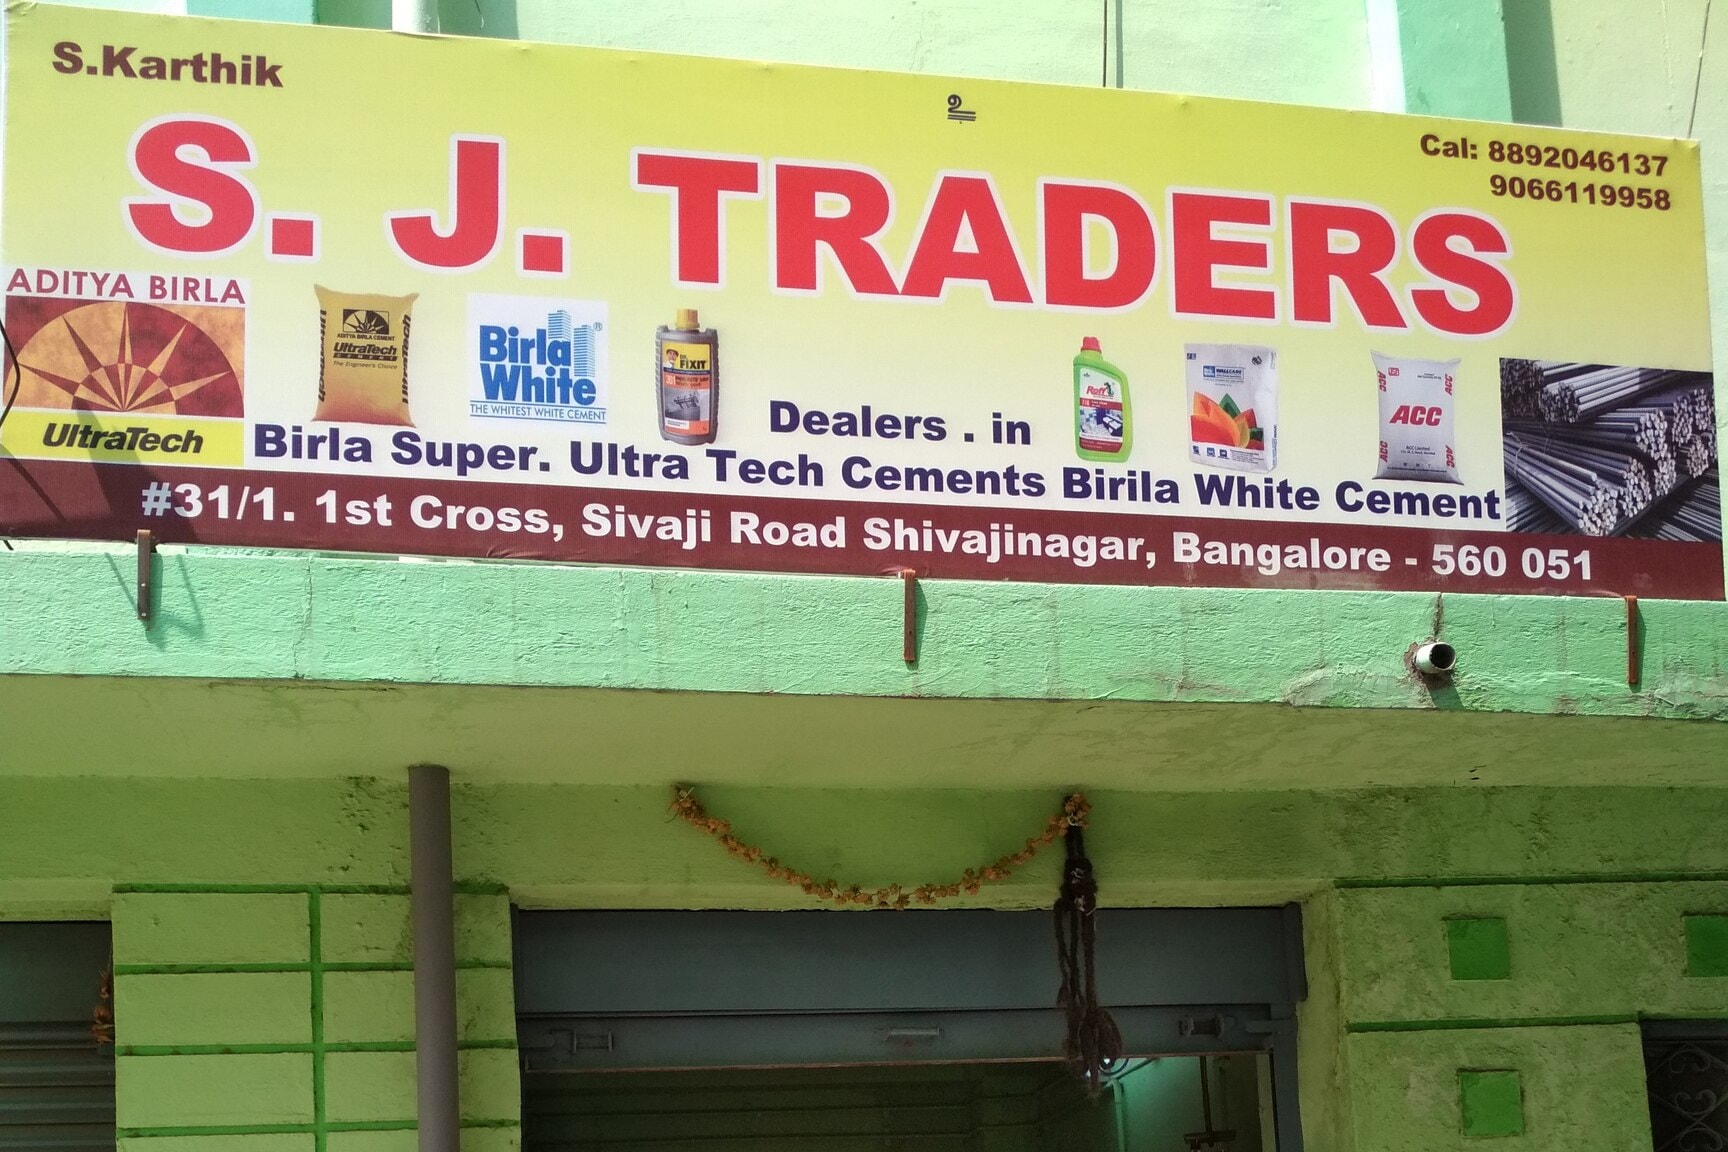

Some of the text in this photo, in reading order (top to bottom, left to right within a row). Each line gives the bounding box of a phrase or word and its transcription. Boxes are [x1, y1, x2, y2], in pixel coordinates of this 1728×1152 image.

[53, 42, 283, 87] S.Karthik
[1421, 134, 1668, 176] Cal: 8892046137
[1490, 175, 1670, 210] 9066119958
[129, 121, 1514, 336] S. J. TRADERS
[7, 269, 245, 304] ADITYA BIRLA
[334, 342, 397, 355] UltraTech
[480, 325, 571, 366] Birla
[480, 363, 596, 405] White
[1445, 374, 1453, 395] ACC
[470, 404, 606, 420] THE WHITEST WHITE CEMENT
[770, 401, 946, 441] Dealers
[993, 413, 1030, 445] in
[1389, 405, 1442, 426] ACC
[43, 423, 203, 453] UltraTech
[255, 424, 1500, 519] Birla Super. Ultra Tech Cements Birila White Cement
[142, 482, 294, 521] #31/1.
[316, 490, 392, 526] 1st
[411, 495, 563, 542] Cross,
[582, 503, 710, 549] Sivaji
[731, 512, 845, 547] Road
[864, 518, 1155, 570] Shivajinagar,
[1174, 532, 1390, 575] Bangalore
[1432, 544, 1506, 576] 560
[1522, 548, 1590, 580] 051
